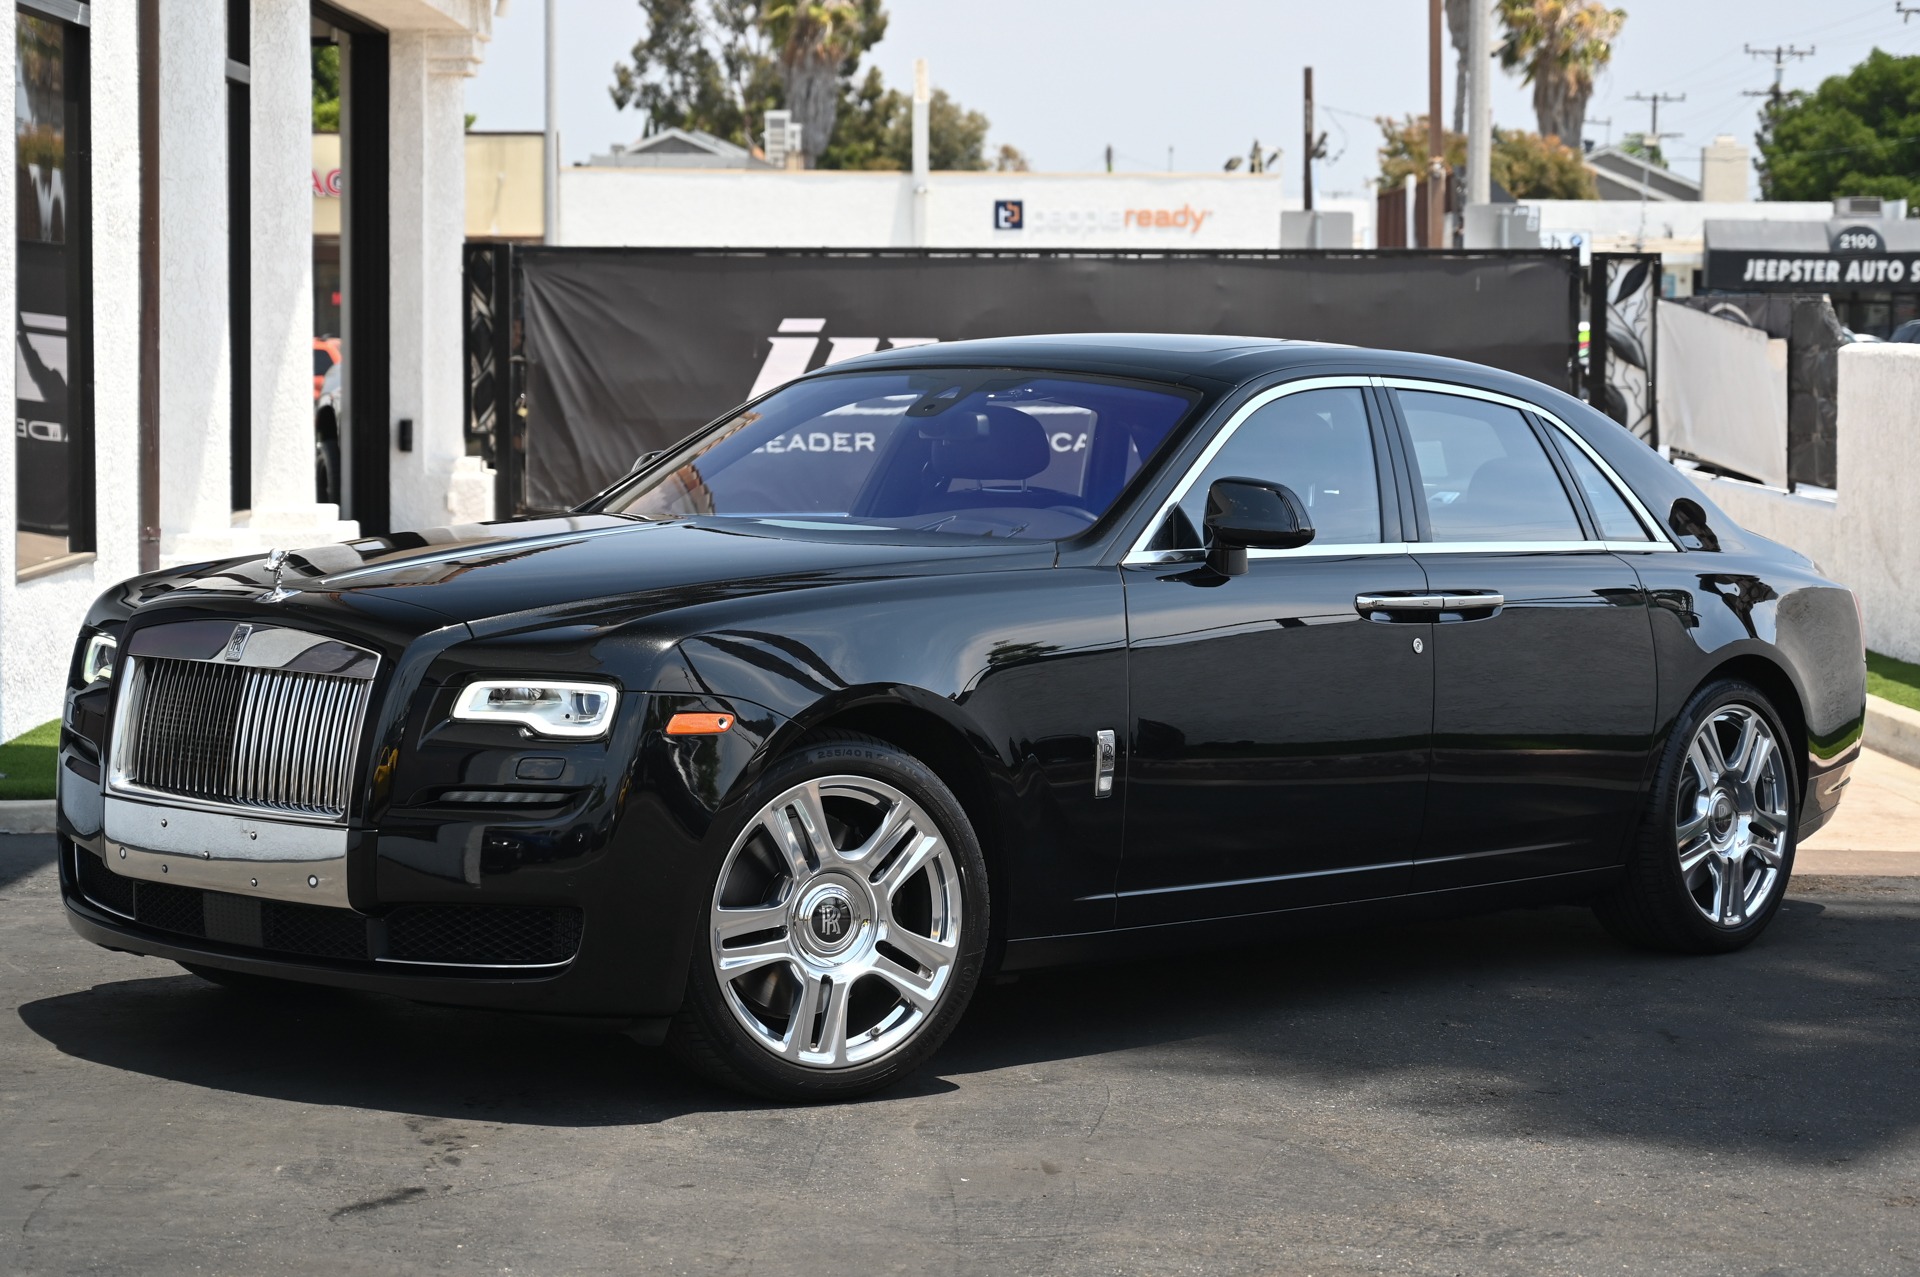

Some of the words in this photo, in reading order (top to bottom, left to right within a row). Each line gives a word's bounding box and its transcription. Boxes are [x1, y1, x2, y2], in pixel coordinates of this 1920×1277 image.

[1839, 233, 1878, 249] 2100
[1743, 258, 1841, 283] JEEPSTER
[1844, 259, 1905, 283] AUTO
[817, 749, 862, 760] 255/40
